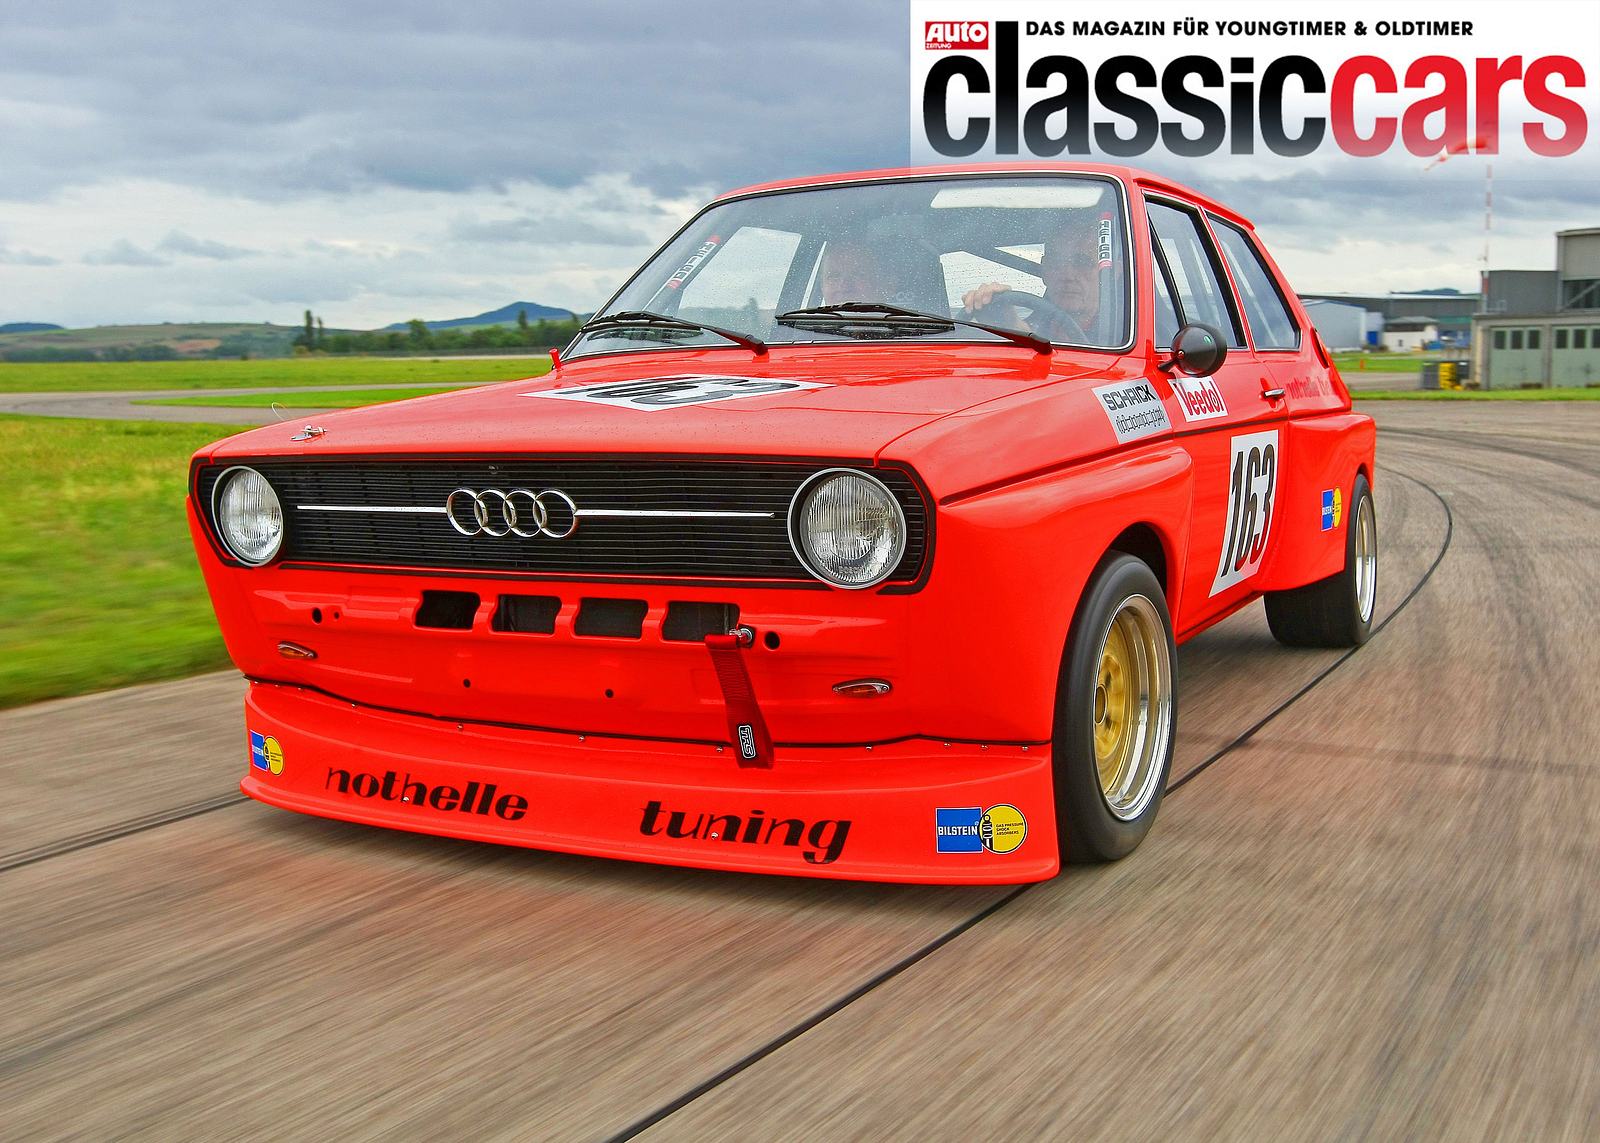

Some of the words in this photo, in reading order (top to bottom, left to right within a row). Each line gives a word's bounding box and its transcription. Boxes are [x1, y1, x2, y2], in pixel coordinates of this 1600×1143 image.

[1102, 384, 1157, 411] SCHRICK
[1172, 380, 1225, 416] Veedol
[1220, 443, 1275, 578] 163
[325, 766, 529, 821] nothelle
[639, 800, 852, 865] tuning
[938, 825, 978, 836] BILSTEIN
